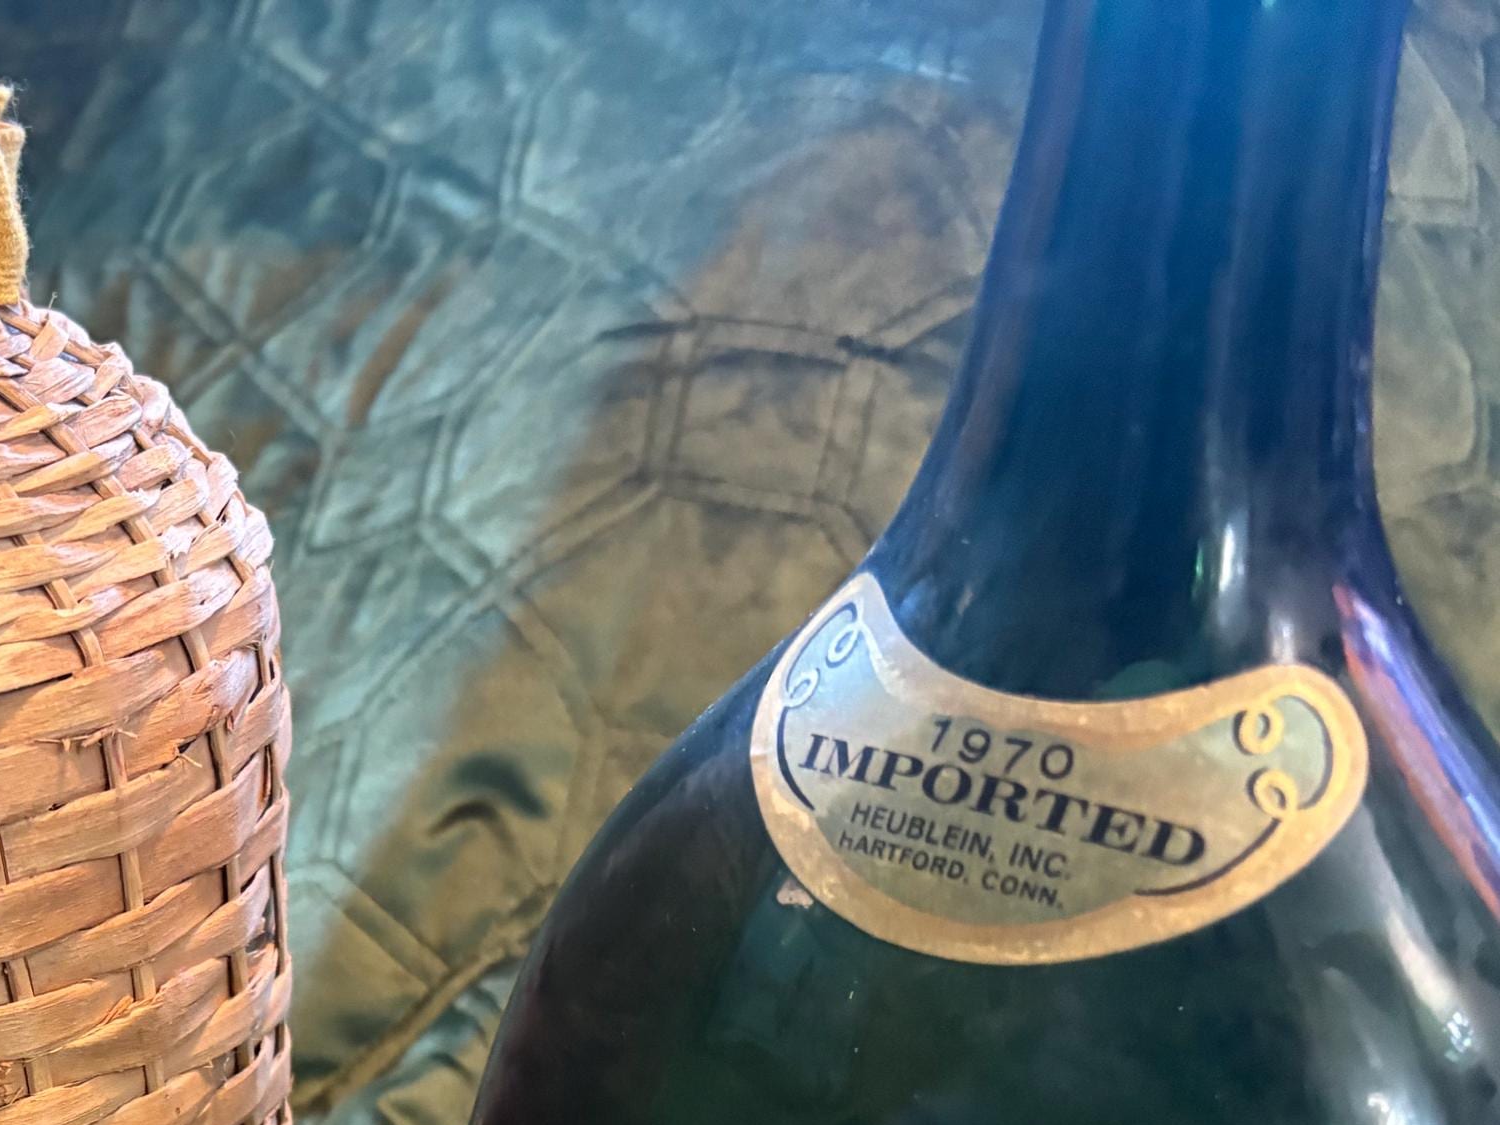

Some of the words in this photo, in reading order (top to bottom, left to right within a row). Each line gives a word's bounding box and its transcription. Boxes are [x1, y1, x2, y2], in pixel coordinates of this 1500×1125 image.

[930, 718, 1076, 781] 1970
[797, 732, 1208, 867] IMPORTED
[849, 801, 996, 863] HEUBLEIN,
[1008, 842, 1074, 881] INC.
[981, 869, 1066, 909] CONN.
